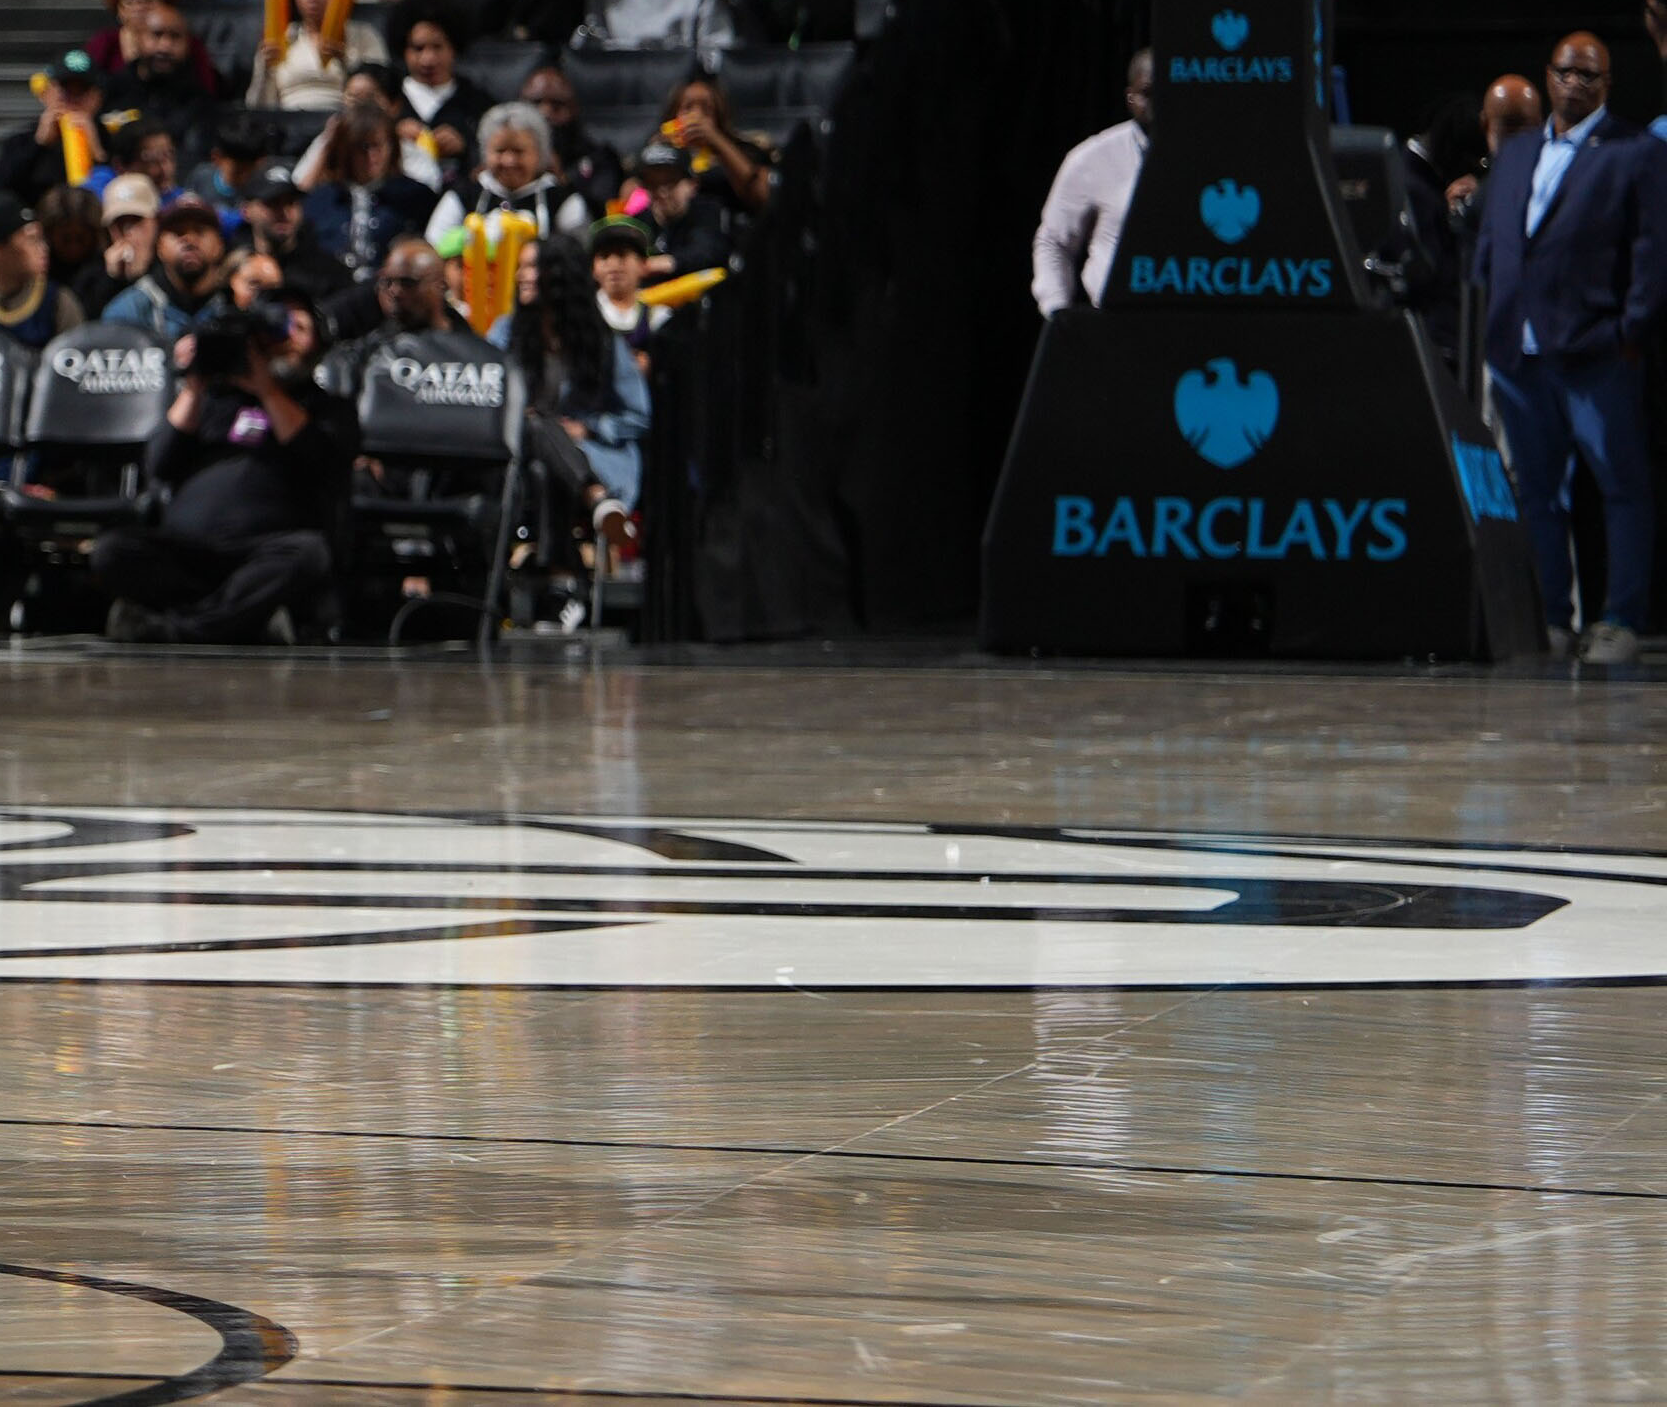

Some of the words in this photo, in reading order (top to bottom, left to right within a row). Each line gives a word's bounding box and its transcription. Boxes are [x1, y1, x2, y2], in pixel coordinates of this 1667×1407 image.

[1170, 55, 1292, 83] BARCLAYS
[1130, 256, 1332, 297] BARCLAYS
[53, 347, 165, 382] QATAR
[390, 357, 504, 392] QATAR
[1052, 496, 1408, 560] BARCLAYS
